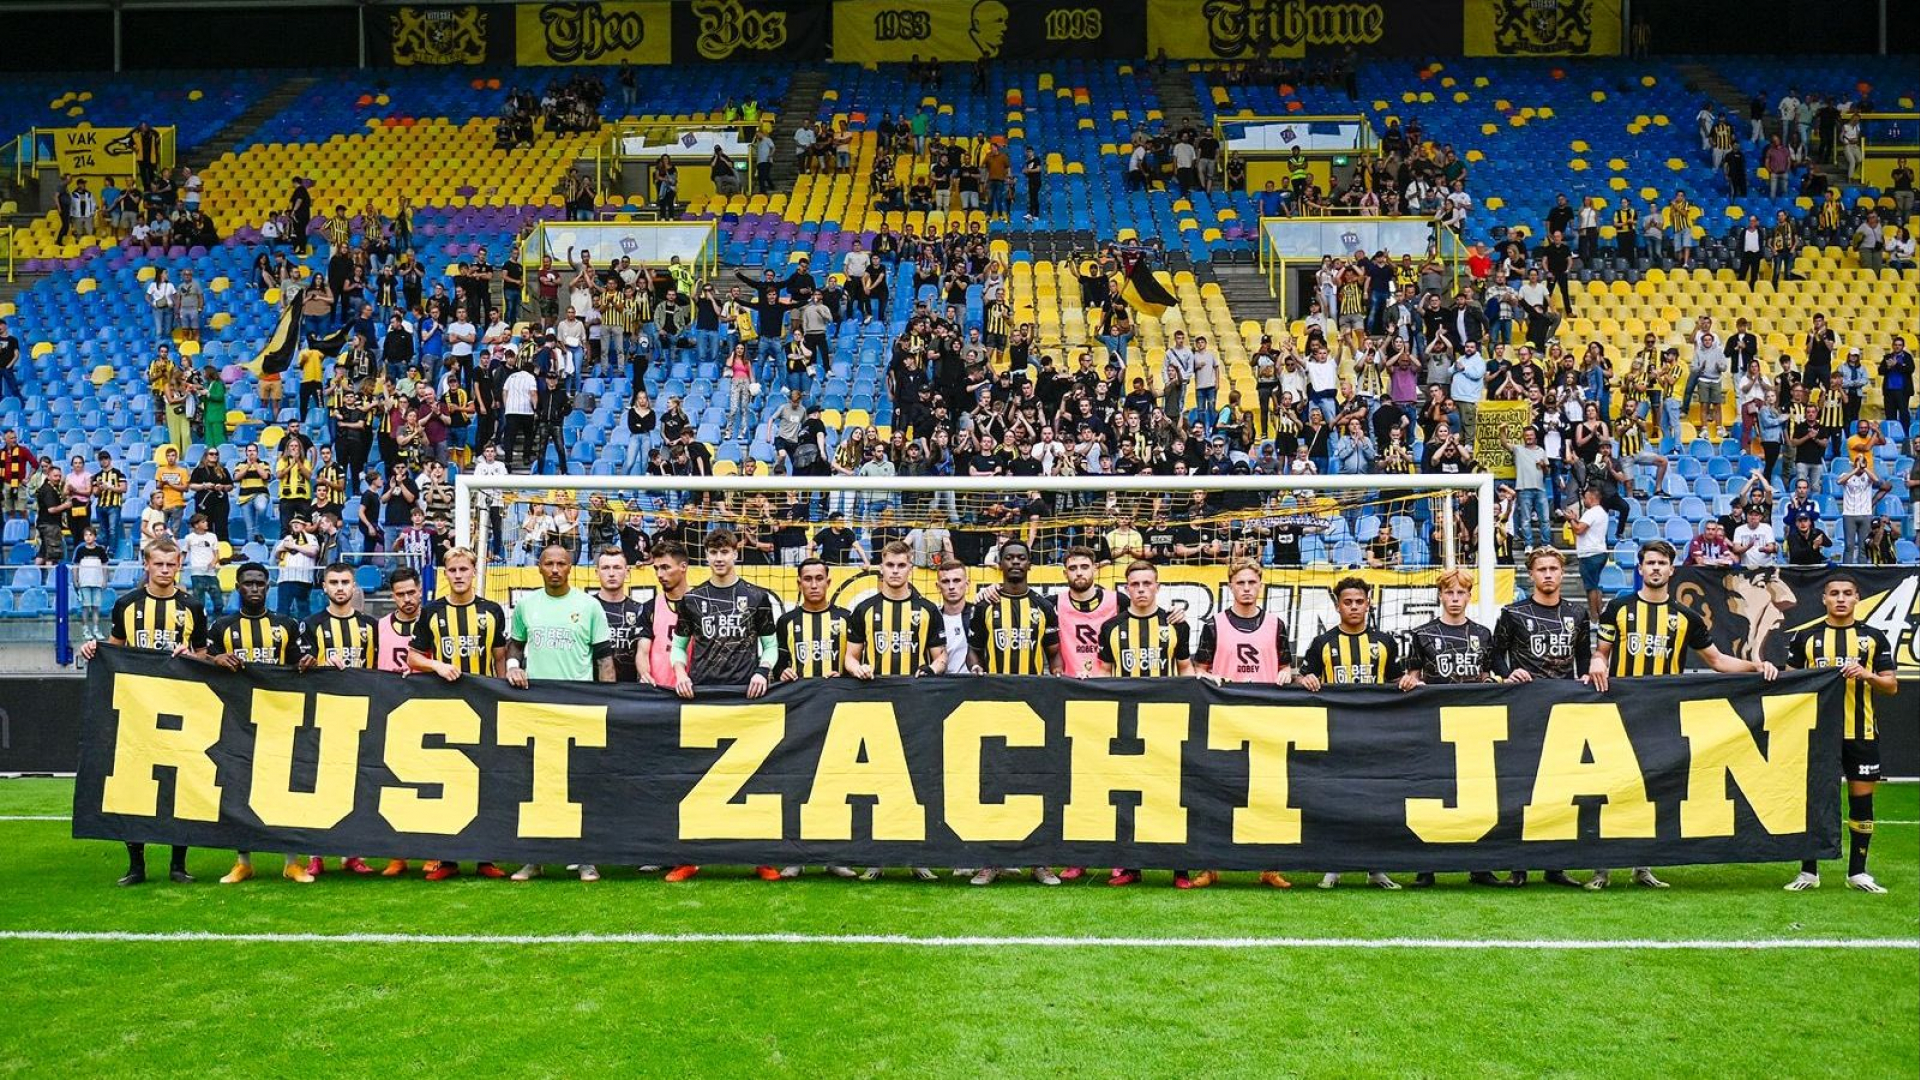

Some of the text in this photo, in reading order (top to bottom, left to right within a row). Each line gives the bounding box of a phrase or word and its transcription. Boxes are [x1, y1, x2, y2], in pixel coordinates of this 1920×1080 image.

[874, 10, 931, 41] 1983
[1045, 9, 1102, 40] 1998
[1202, 0, 1384, 57] Tribune
[539, 0, 787, 62] Theo Bos
[67, 132, 97, 145] VAK
[73, 155, 95, 168] 214
[719, 615, 743, 626] BET
[154, 630, 179, 641] BET
[547, 628, 571, 639] BET
[609, 628, 631, 638] BET
[718, 626, 746, 637] CITY
[893, 631, 915, 642] BET
[1010, 628, 1034, 639] BET
[459, 635, 481, 646] BET
[546, 639, 576, 650] CITY
[610, 638, 633, 649] CITY
[1010, 639, 1036, 650] CITY
[1550, 633, 1573, 645] BET
[1645, 634, 1670, 646] BET
[813, 640, 835, 650] BET
[892, 642, 918, 653] CITY
[1076, 645, 1099, 653] ROBEY
[252, 647, 276, 658] BET
[343, 647, 363, 658] BET
[459, 646, 485, 657] CITY
[813, 650, 838, 661] CITY
[1140, 648, 1163, 659] BET
[1645, 646, 1672, 658] CITY
[1455, 653, 1479, 664] BET
[1140, 659, 1167, 670] CITY
[1237, 665, 1260, 673] ROBEY
[1351, 664, 1374, 675] BET
[1455, 664, 1481, 676] CITY
[102, 672, 1818, 845] RUST ZACHT JAN
